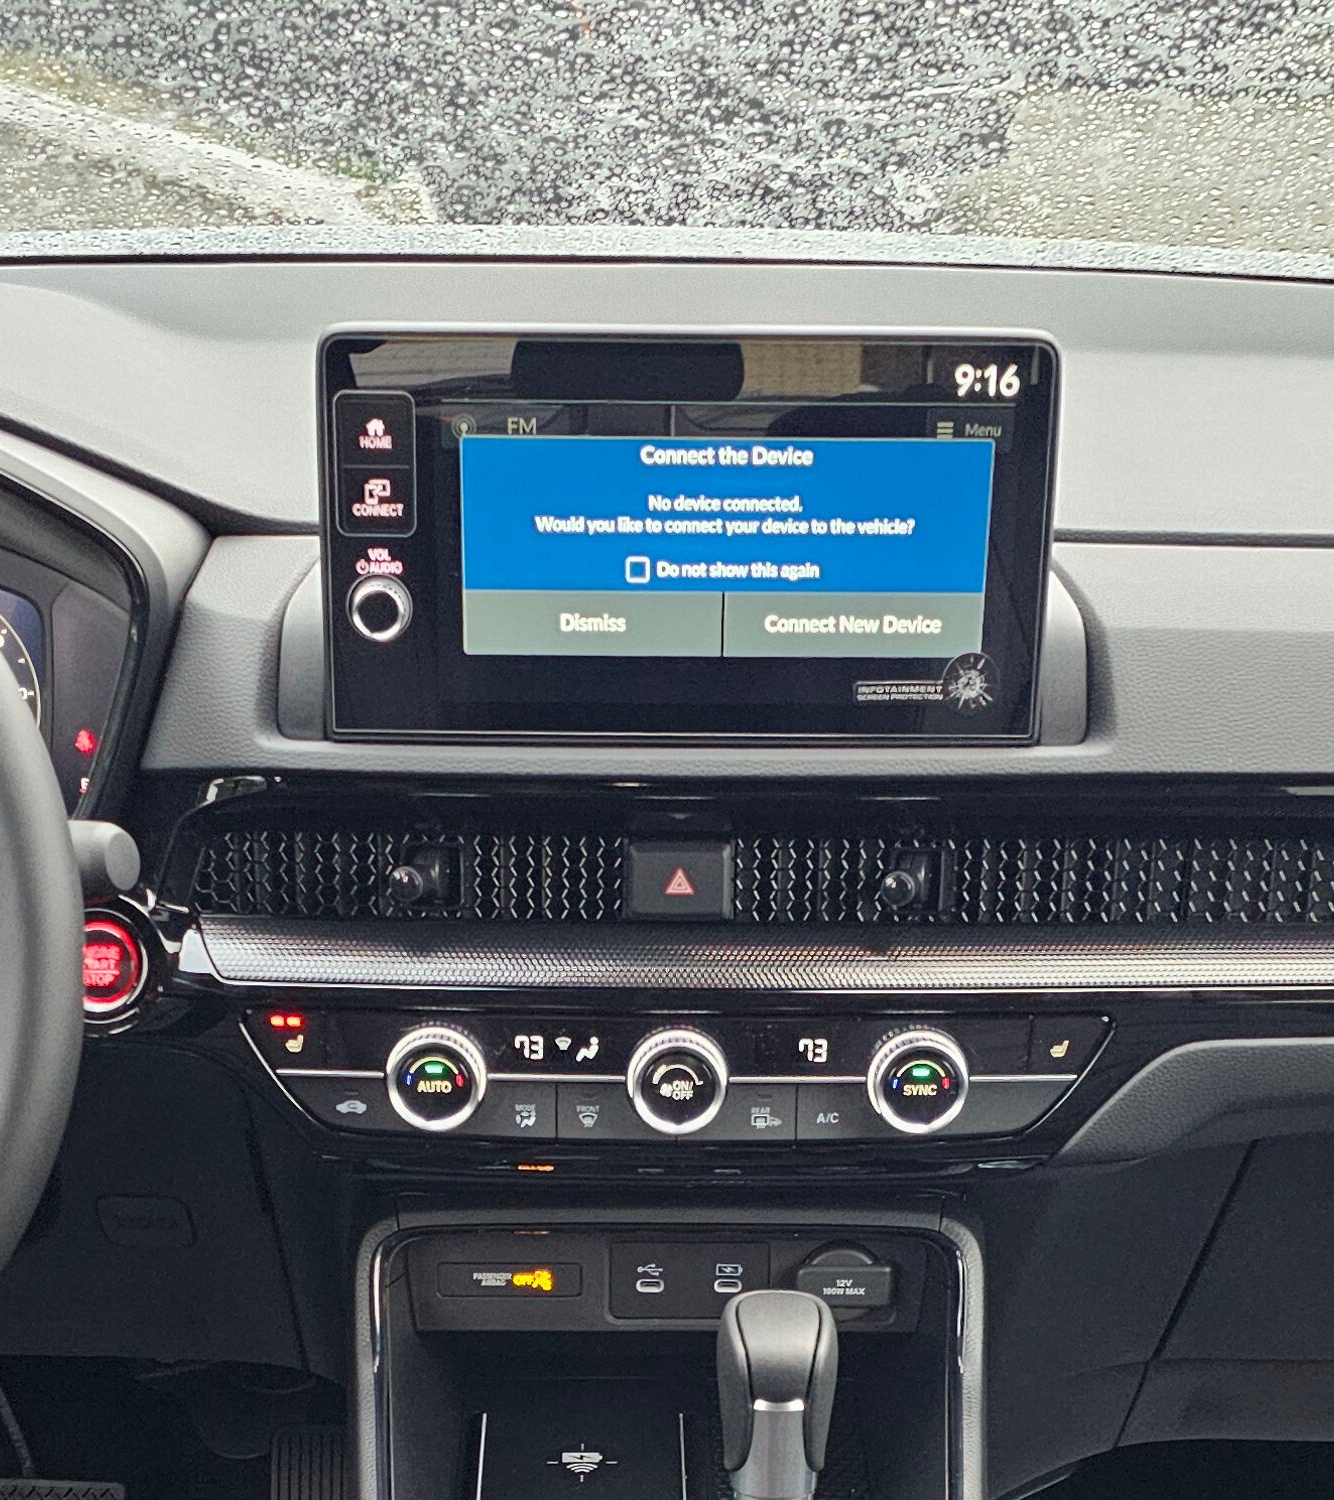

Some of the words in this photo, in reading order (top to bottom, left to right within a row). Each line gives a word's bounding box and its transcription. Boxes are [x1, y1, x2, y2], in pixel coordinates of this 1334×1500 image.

[954, 363, 1021, 397] 9:16
[507, 417, 536, 435] FM
[965, 423, 1002, 438] Menu
[359, 436, 392, 449] HOME
[640, 445, 715, 466] Connect
[718, 446, 749, 466] the
[752, 446, 814, 466] Device
[648, 495, 671, 512] No
[674, 494, 721, 512] device
[723, 495, 803, 512] connected.
[351, 503, 404, 517] CONNECT
[534, 516, 585, 534] Would
[587, 519, 615, 536] you
[617, 517, 644, 534] like
[646, 517, 662, 534] to
[664, 518, 724, 535] connect
[726, 520, 760, 537] your
[761, 518, 810, 536] device
[811, 520, 827, 536] to
[829, 519, 855, 536] the
[857, 518, 916, 536] vehicle?
[367, 548, 391, 561] VOL
[369, 561, 403, 574] AUDIO
[656, 561, 679, 578] Do
[681, 562, 707, 578] not
[709, 561, 749, 578] show
[751, 561, 780, 579] this
[783, 563, 820, 581] again
[559, 612, 627, 635] Dismiss
[764, 614, 836, 634] Connect
[839, 615, 880, 634] New
[883, 615, 943, 635] Device
[857, 685, 943, 694] INFOTAINMENT
[890, 693, 943, 701] PROTECTION
[515, 1035, 543, 1060] 73
[798, 1038, 827, 1062] 73
[417, 1081, 452, 1094] AUTO
[672, 1080, 694, 1092] ON/
[903, 1084, 937, 1097] SYNC
[672, 1090, 694, 1101] OFF
[816, 1112, 839, 1125] A/C
[473, 1272, 512, 1280] PASSENGER
[513, 1275, 534, 1286] OFF
